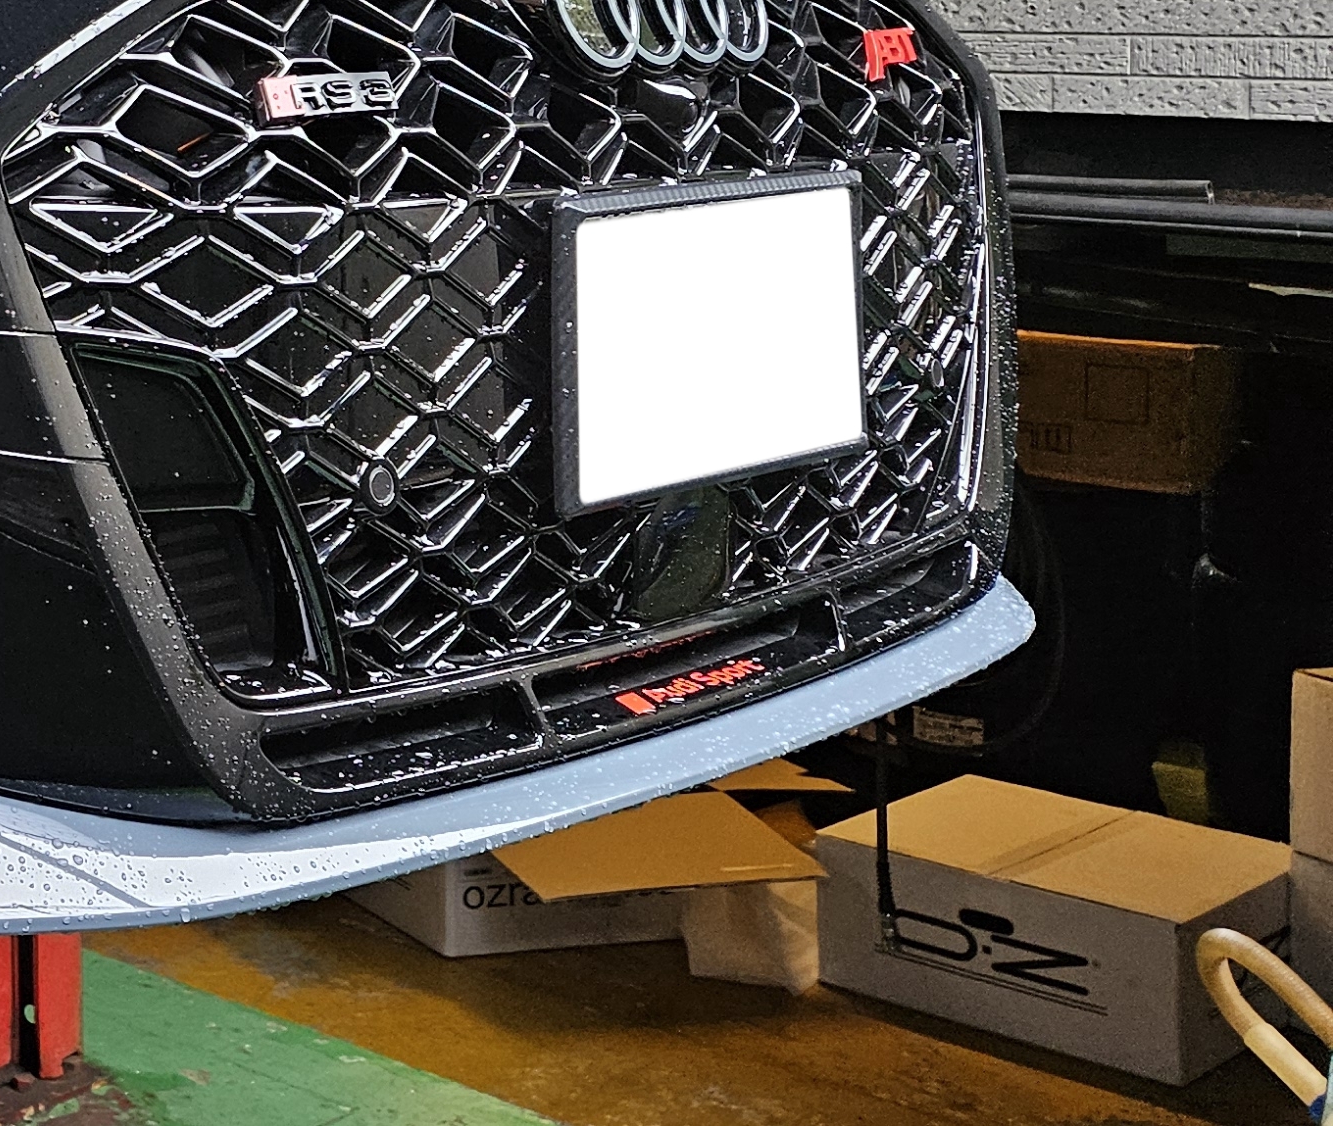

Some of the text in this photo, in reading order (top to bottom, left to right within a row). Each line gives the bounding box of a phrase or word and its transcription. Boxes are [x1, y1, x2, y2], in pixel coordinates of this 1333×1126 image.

[863, 27, 917, 82] ABT
[642, 659, 766, 703] Audi Sport
